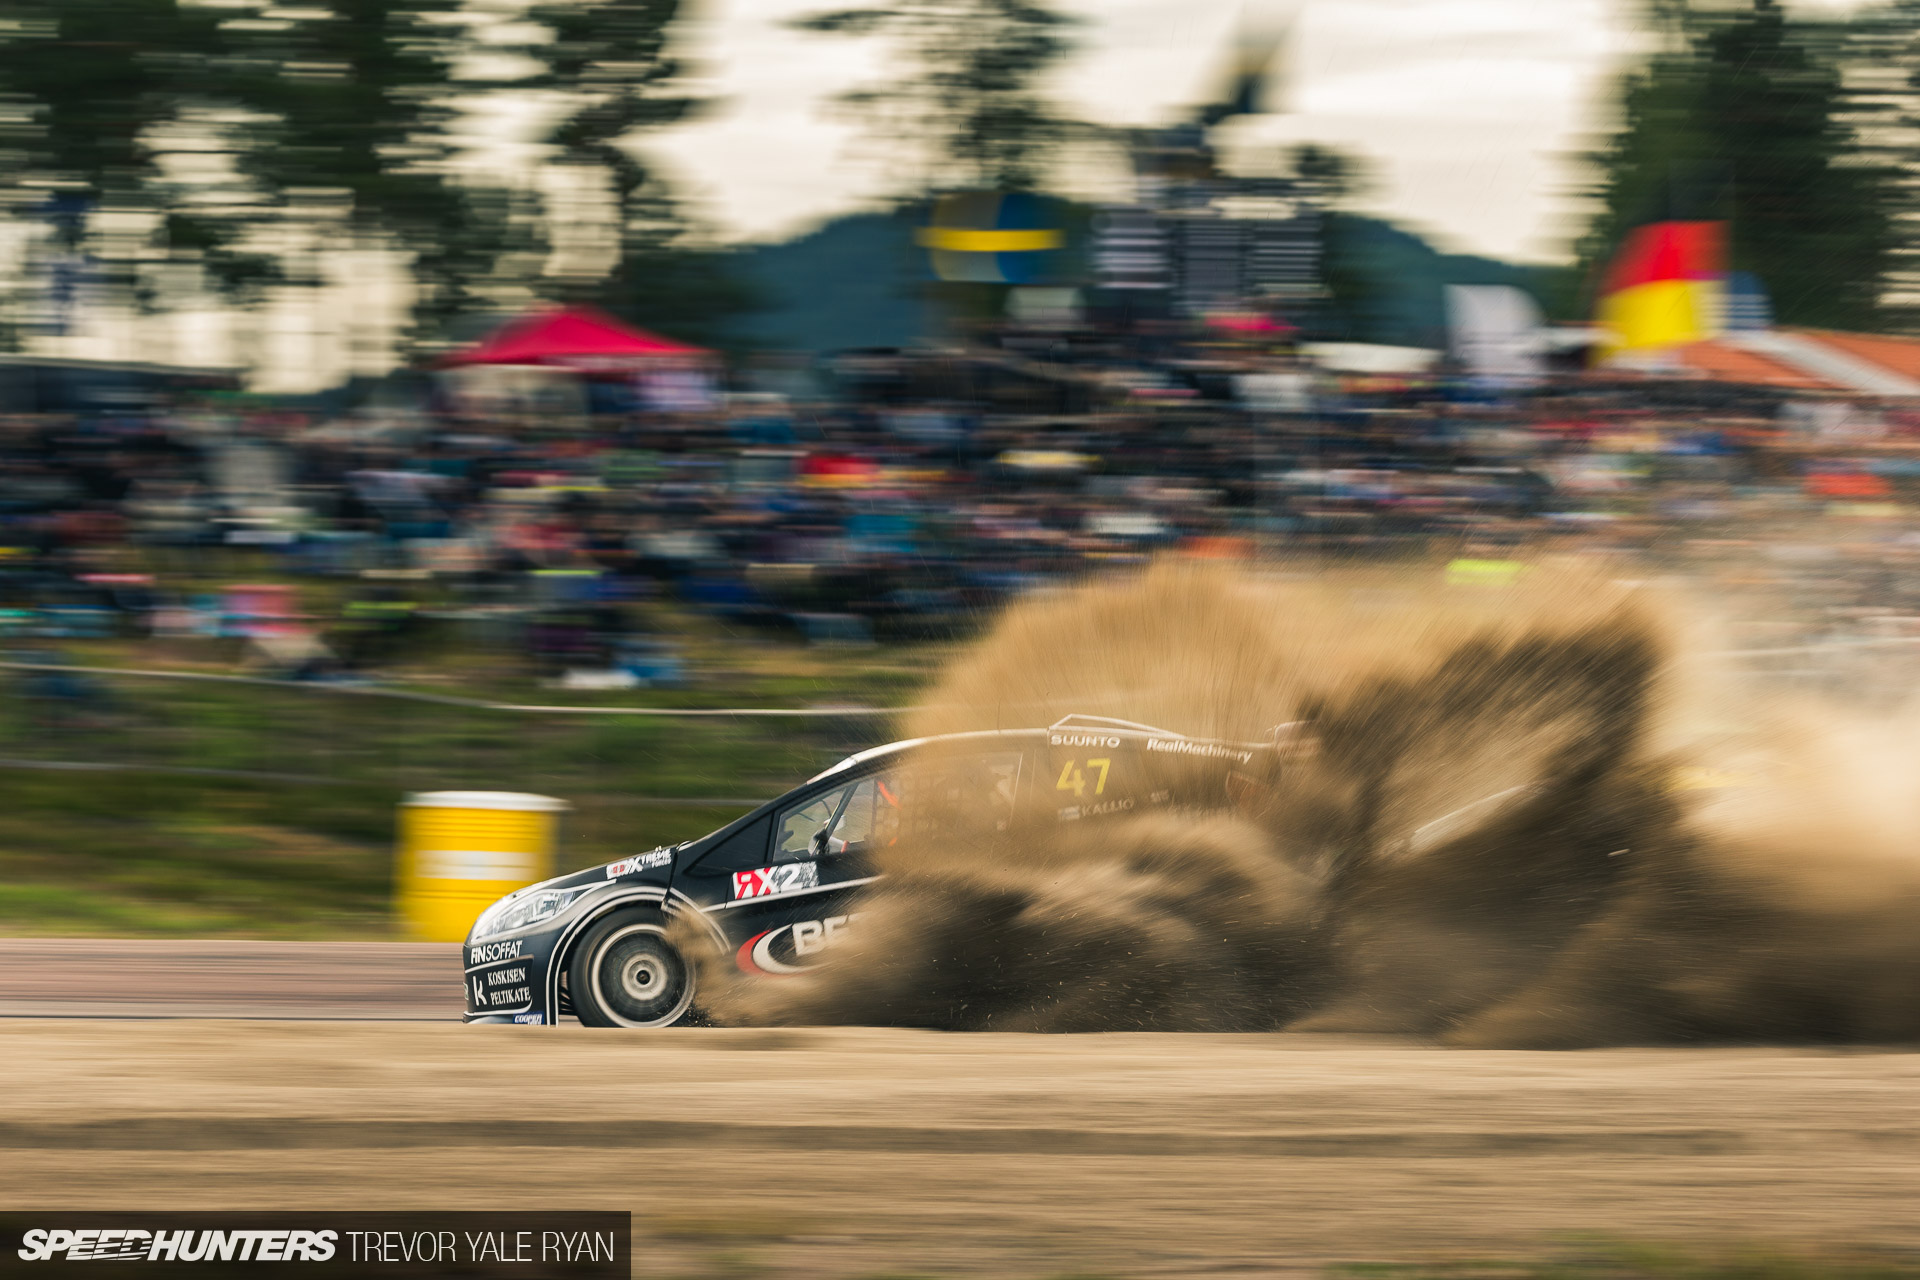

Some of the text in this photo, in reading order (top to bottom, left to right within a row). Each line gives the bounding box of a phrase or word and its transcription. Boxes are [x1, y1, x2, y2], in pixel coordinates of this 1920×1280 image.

[1050, 734, 1121, 749] SUUNTO
[1146, 738, 1254, 764] RealMachinery
[1056, 757, 1112, 797] 47
[487, 967, 526, 987] KOSKISEN
[490, 986, 531, 1006] PELTIKATE
